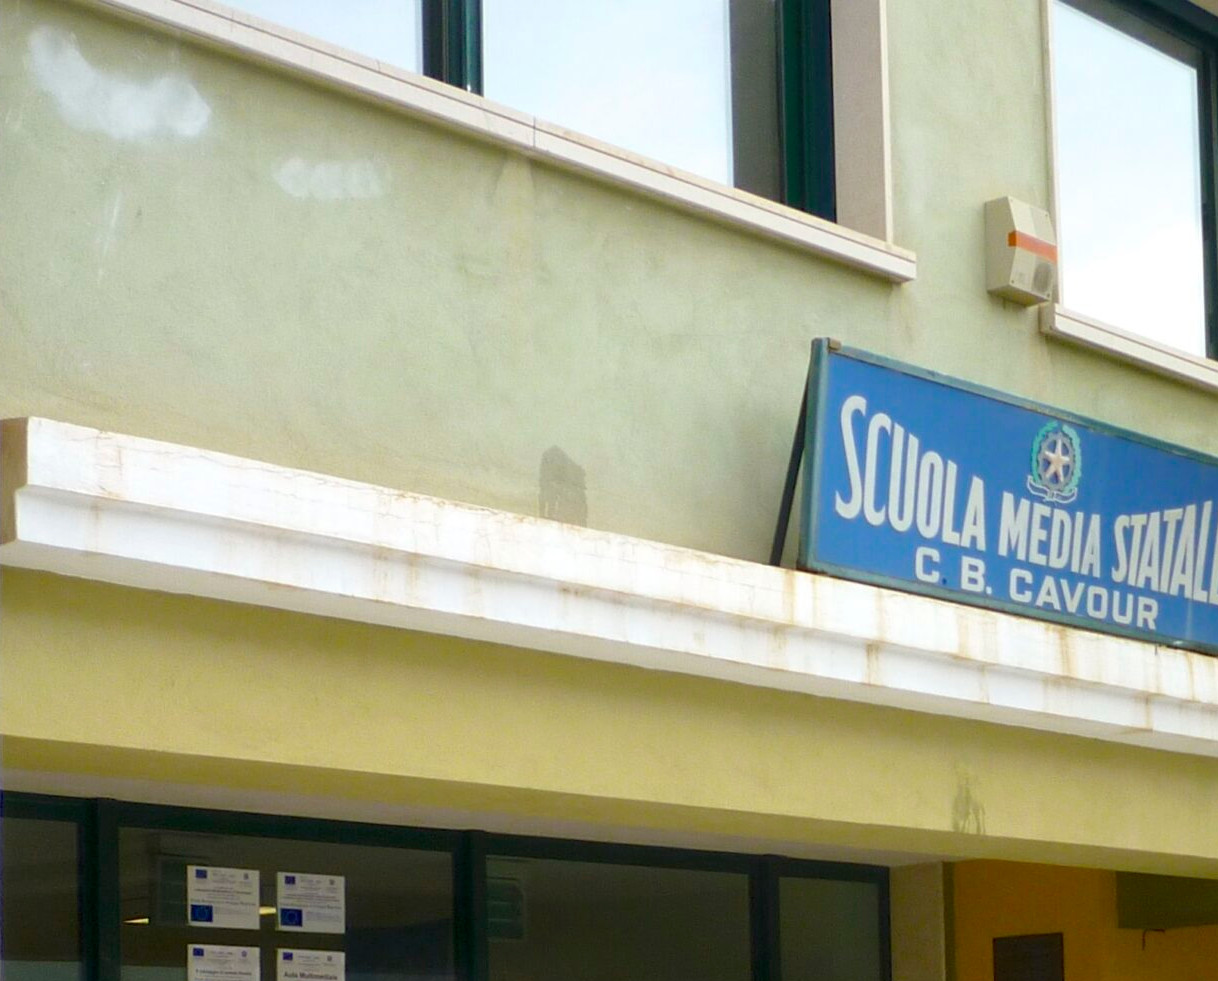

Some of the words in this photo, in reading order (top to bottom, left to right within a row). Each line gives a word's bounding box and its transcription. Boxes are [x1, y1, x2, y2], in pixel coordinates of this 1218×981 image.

[835, 395, 986, 551] SCUOLA
[998, 491, 1100, 578] MEDIA
[961, 555, 992, 595] B.
[1009, 568, 1159, 630] CAVOUR
